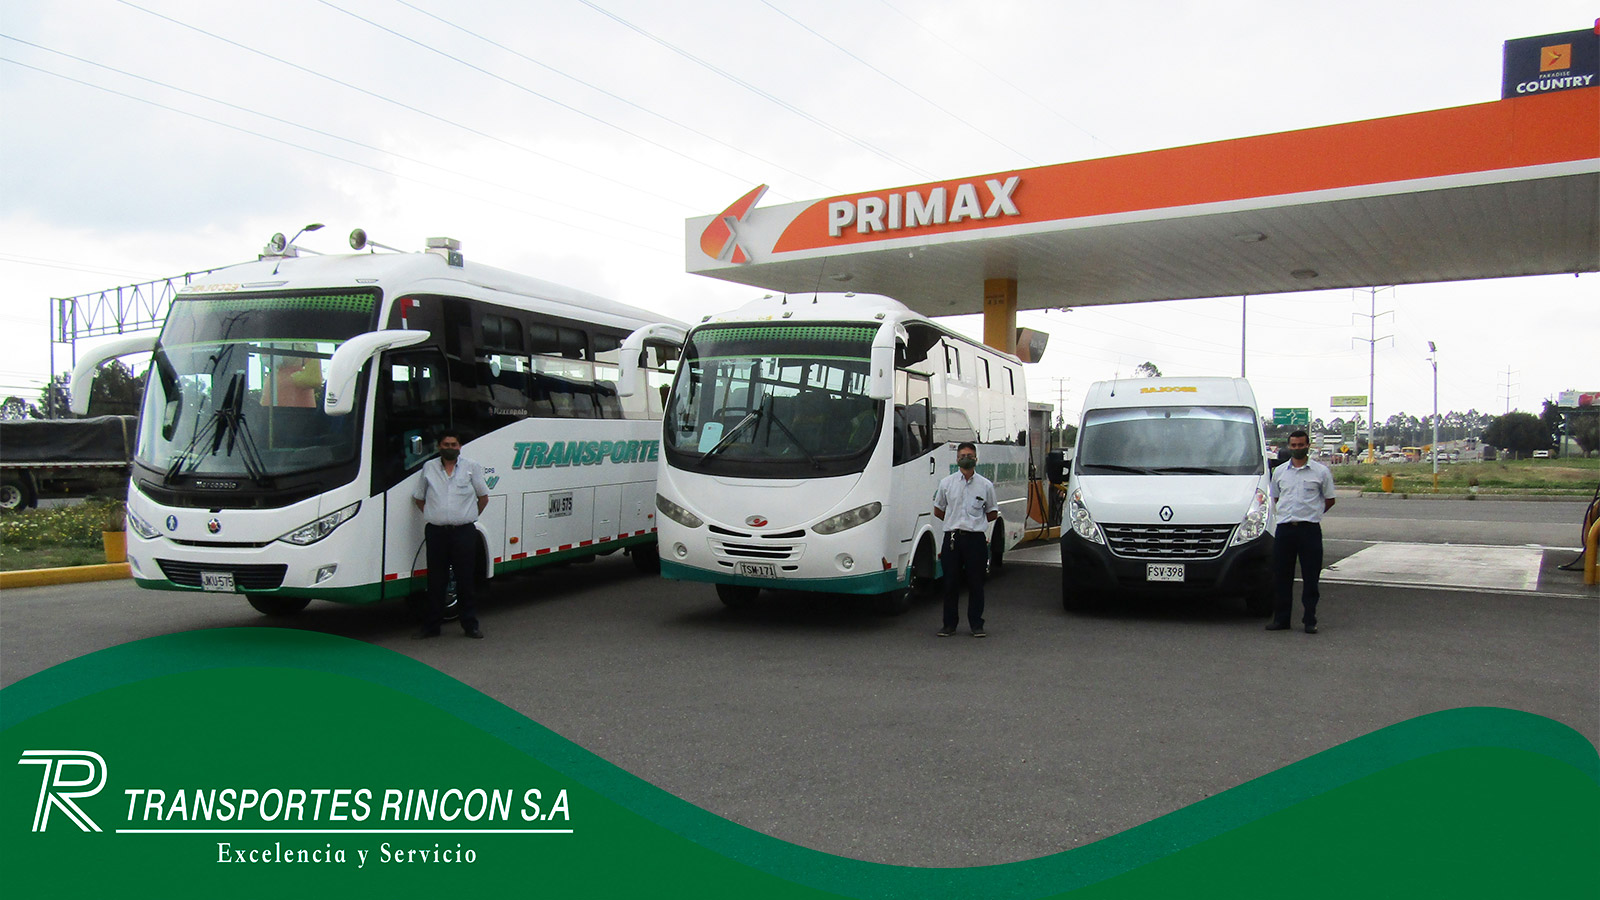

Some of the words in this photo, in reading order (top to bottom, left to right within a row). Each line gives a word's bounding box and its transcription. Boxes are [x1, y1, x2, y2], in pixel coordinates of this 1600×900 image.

[1516, 74, 1593, 93] COUNTRY
[1539, 71, 1570, 79] PARADISE
[829, 176, 1021, 237] PRIMAX
